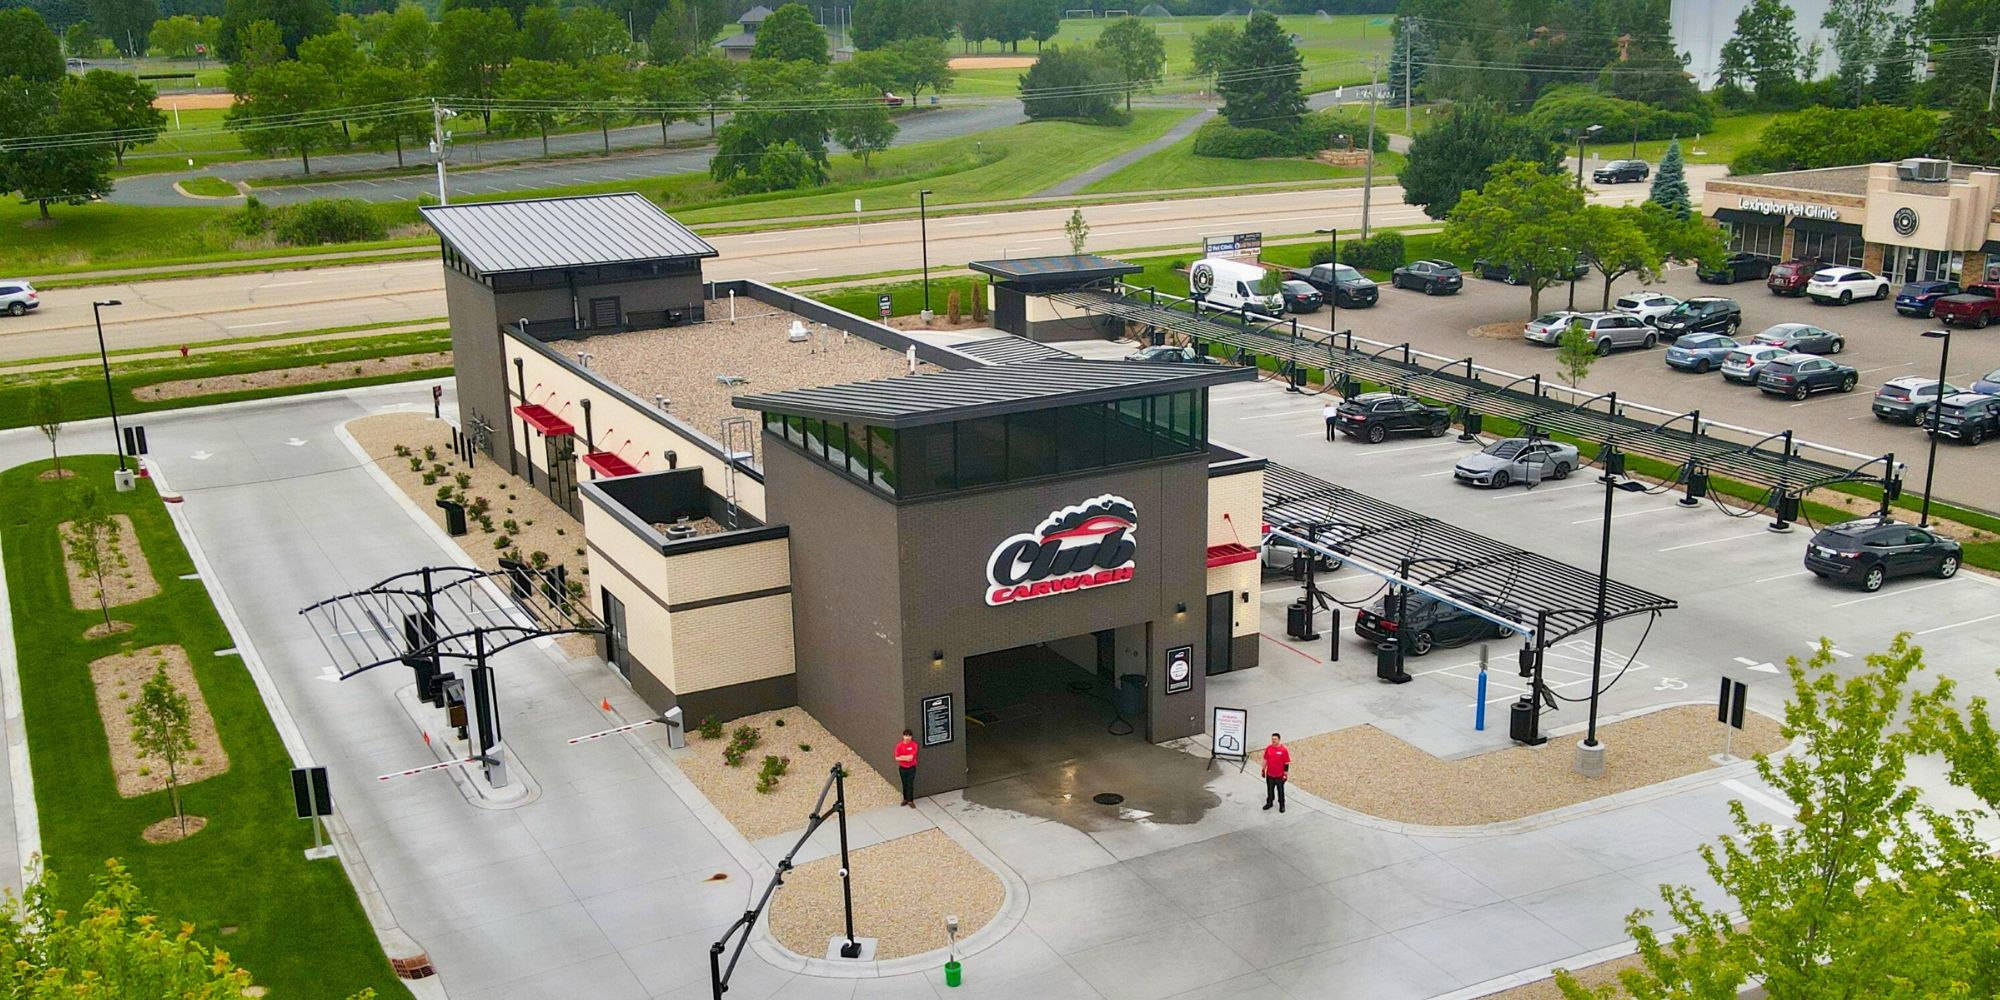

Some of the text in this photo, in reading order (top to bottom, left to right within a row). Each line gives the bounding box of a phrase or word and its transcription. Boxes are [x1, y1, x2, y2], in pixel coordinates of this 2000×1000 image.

[1738, 197, 1838, 220] Lexington Pet Clinic
[993, 527, 1136, 586] Club
[991, 567, 1136, 603] CARWASH
